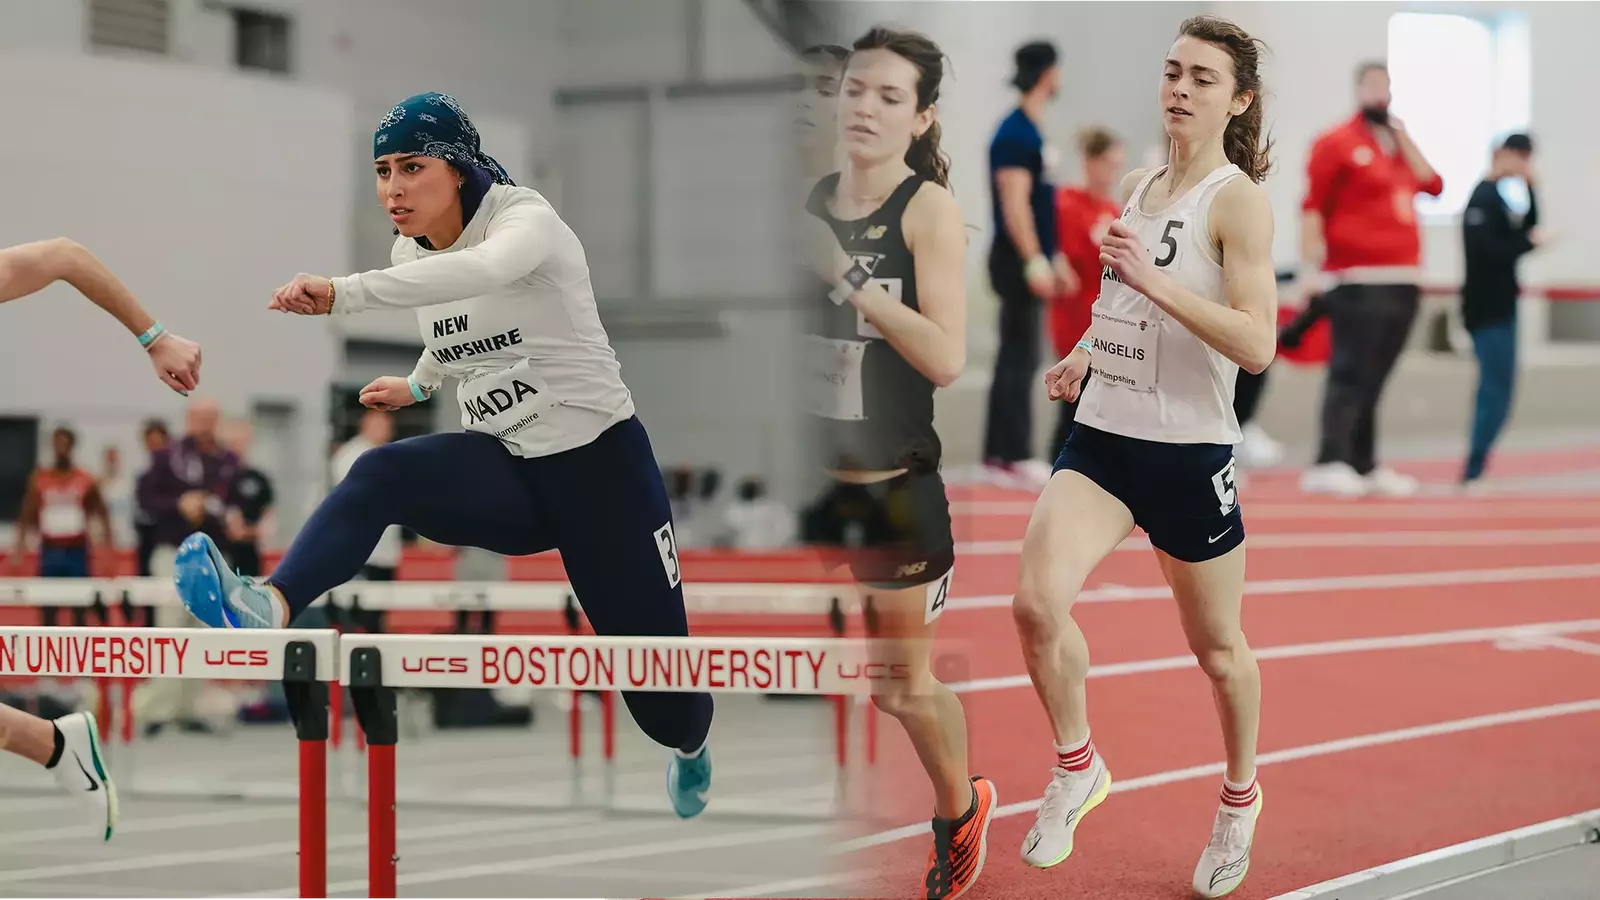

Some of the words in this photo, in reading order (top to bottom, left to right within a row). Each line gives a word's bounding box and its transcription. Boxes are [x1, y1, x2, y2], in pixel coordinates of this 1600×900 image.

[1154, 220, 1184, 267] 5
[433, 314, 468, 338] NEW
[1099, 368, 1136, 386] Hampshire
[464, 379, 539, 425] NADA
[495, 412, 539, 439] Hampshire
[1220, 462, 1238, 511] 5
[661, 528, 680, 583] 3
[931, 575, 947, 612] 4
[0, 635, 15, 672] N
[26, 635, 189, 675] UNIVERSITY
[204, 649, 268, 666] UCS
[402, 656, 468, 673] UCS
[482, 647, 614, 686] BOSTON
[628, 649, 826, 689] UNIVERSITY
